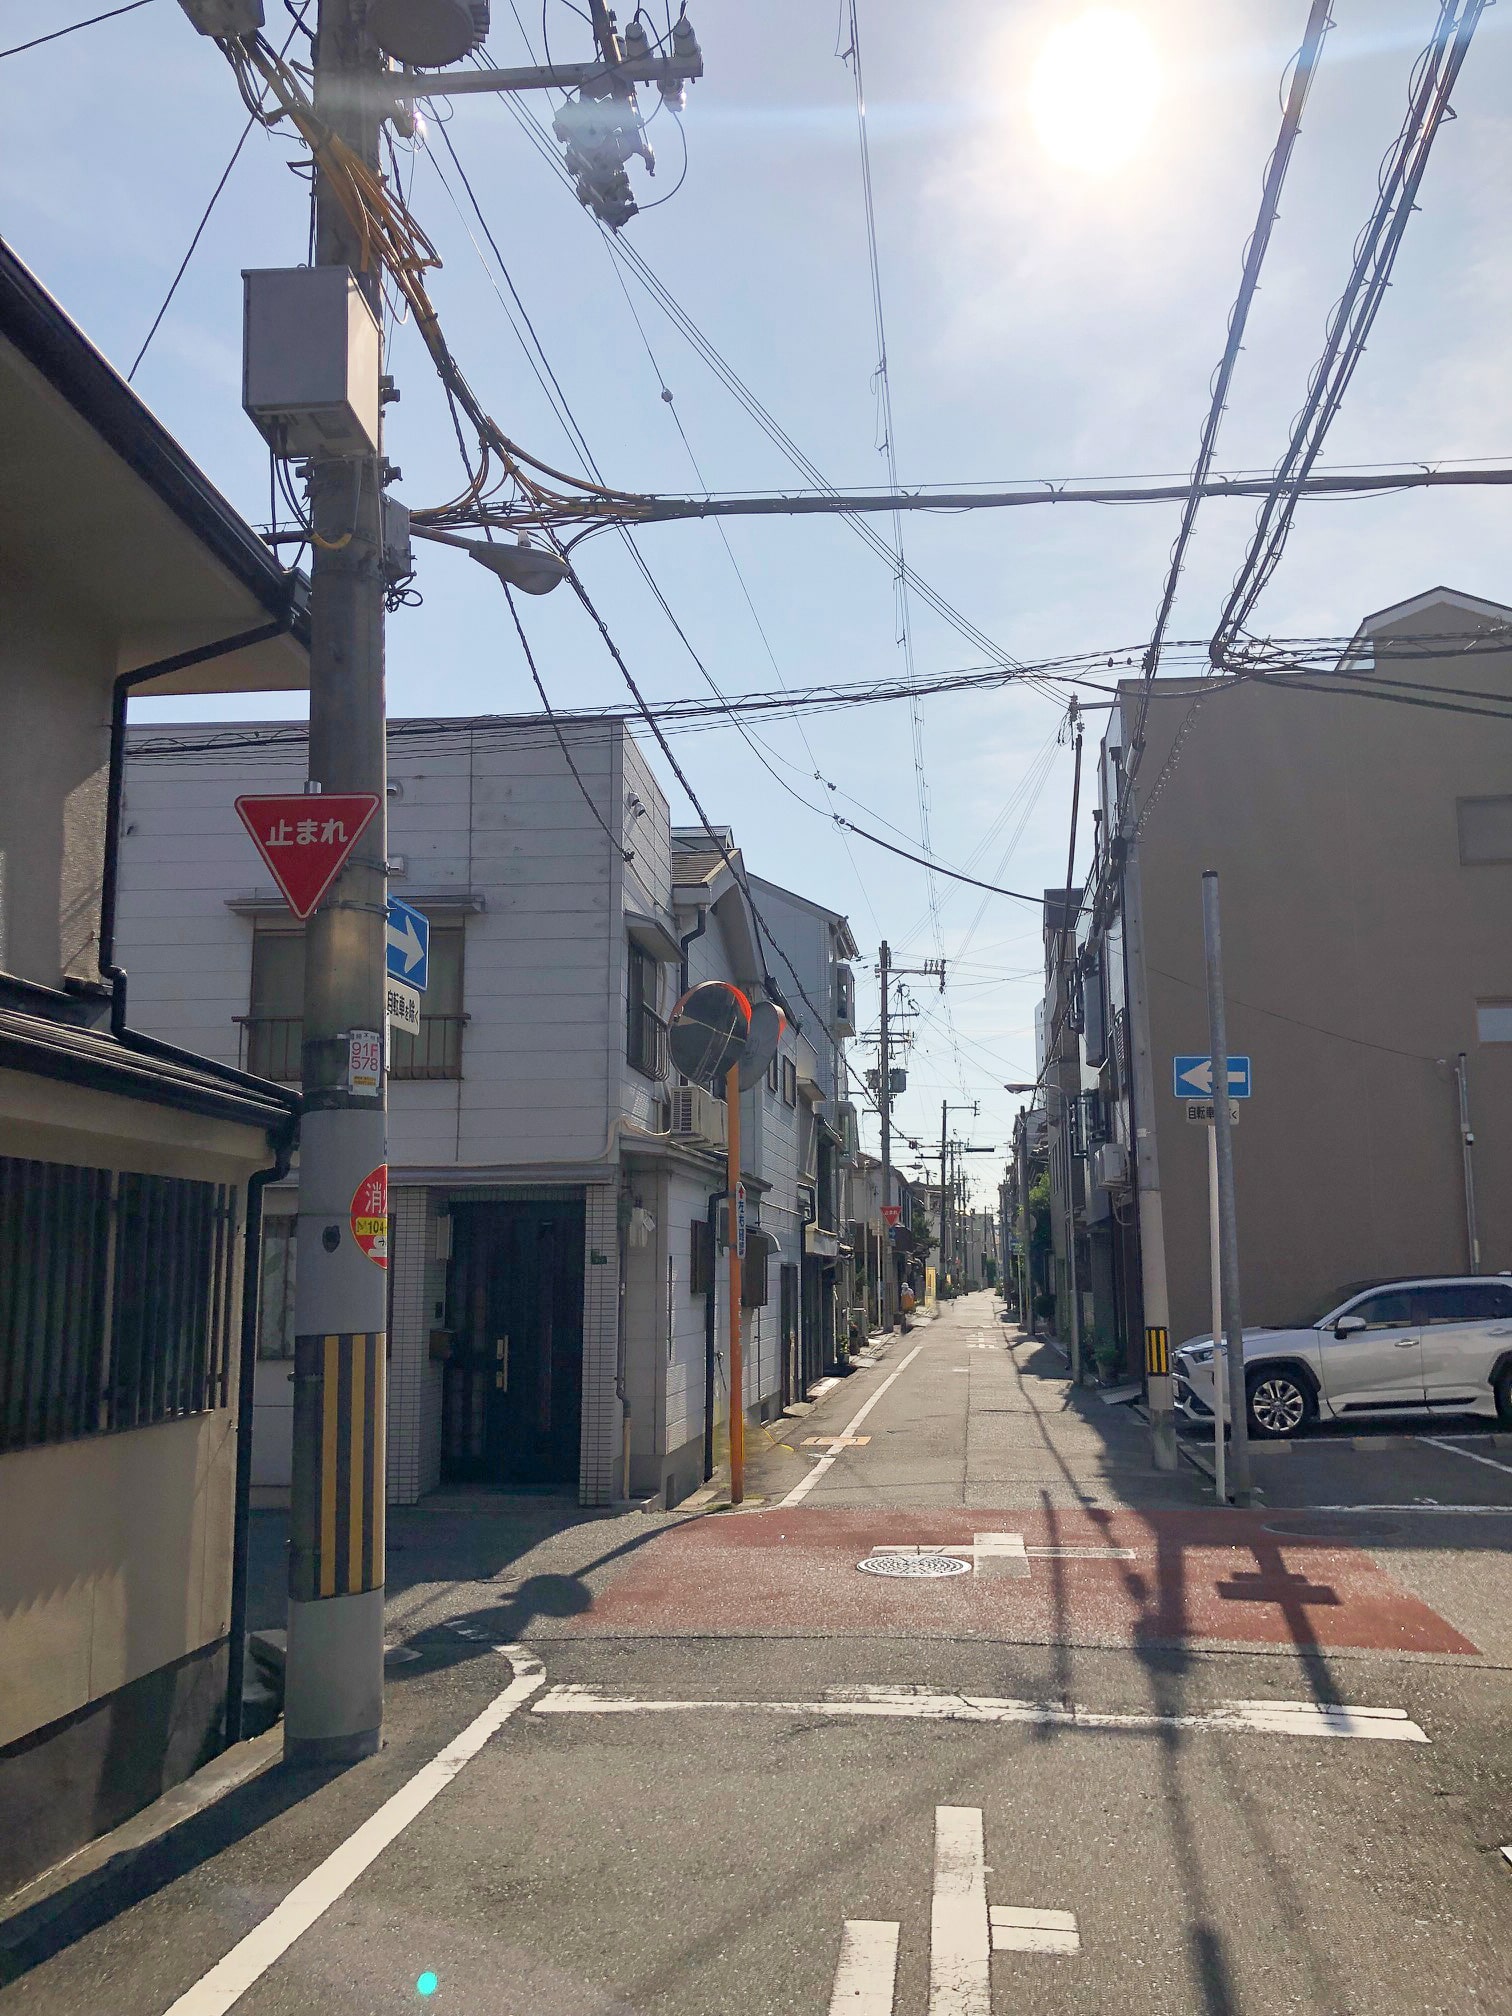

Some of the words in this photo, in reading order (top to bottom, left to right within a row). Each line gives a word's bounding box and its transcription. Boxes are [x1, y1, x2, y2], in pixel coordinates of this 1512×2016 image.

[265, 817, 349, 846] 止まれ
[352, 1041, 378, 1057] 91F
[351, 1056, 378, 1072] 578
[1188, 1106, 1237, 1120] 自転車く
